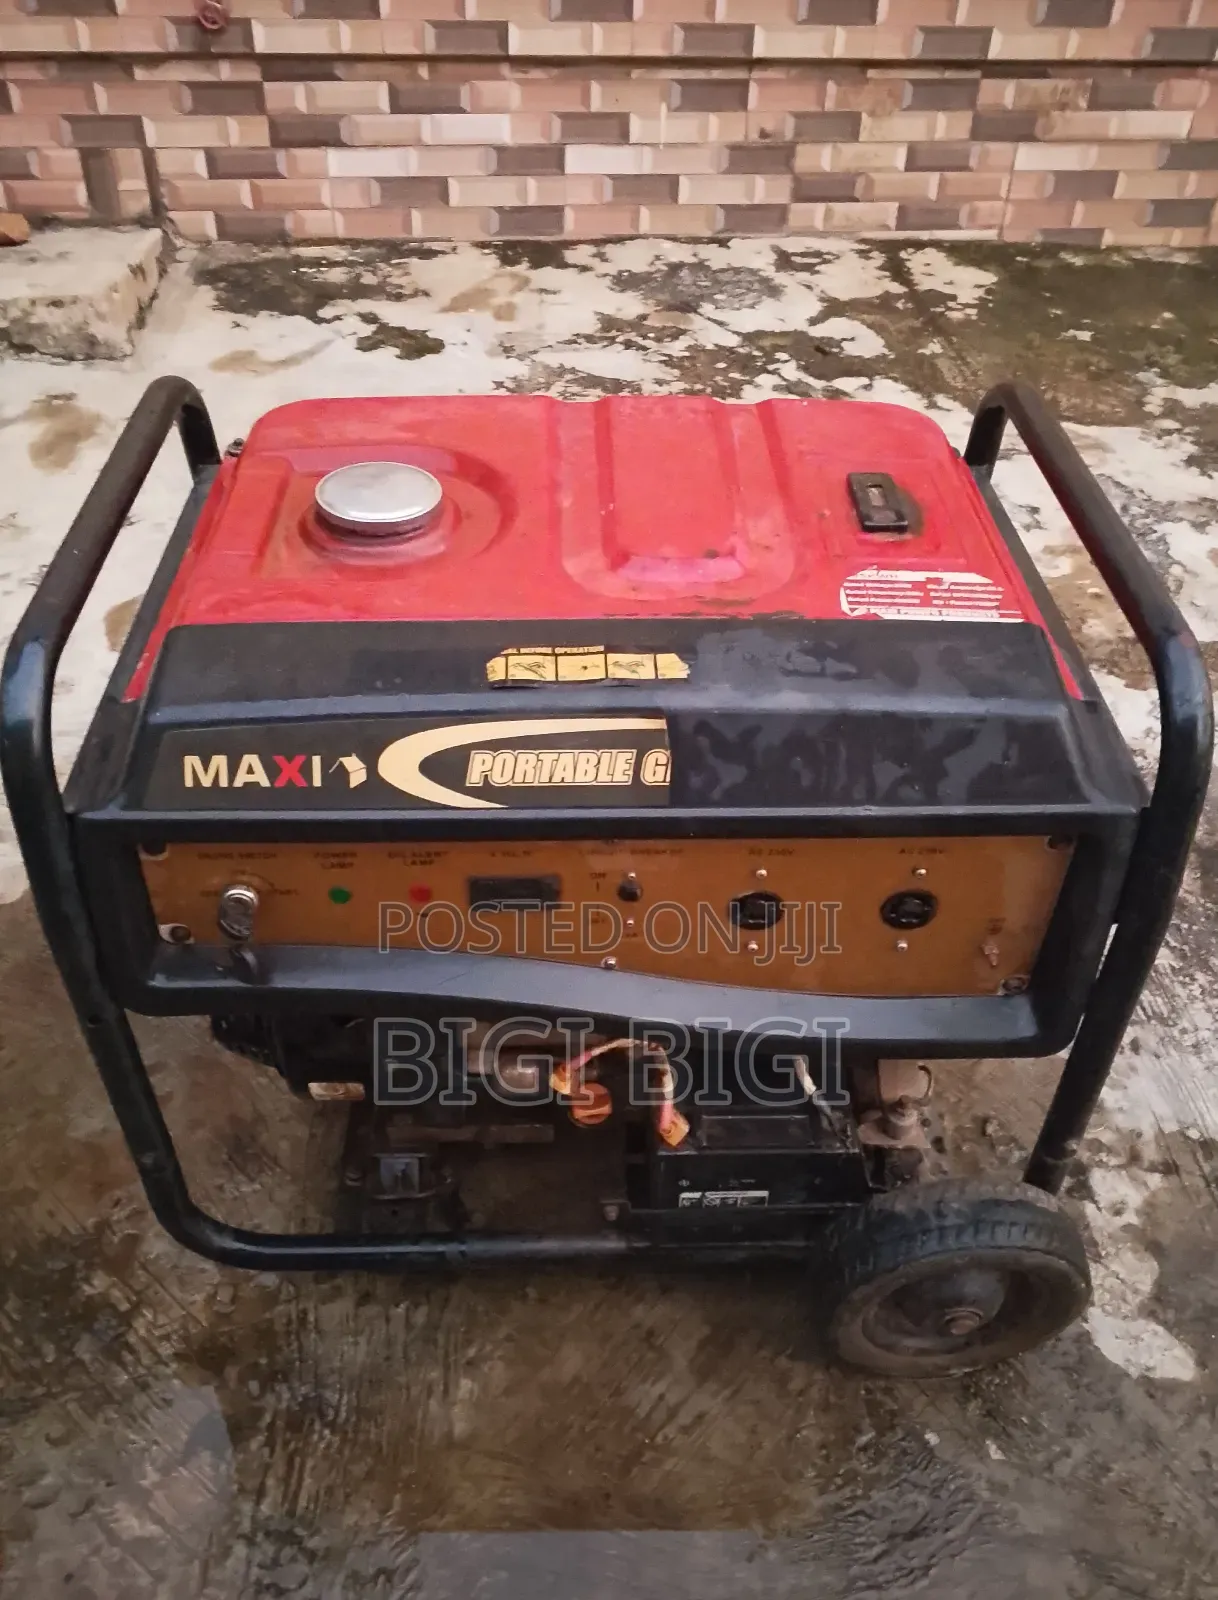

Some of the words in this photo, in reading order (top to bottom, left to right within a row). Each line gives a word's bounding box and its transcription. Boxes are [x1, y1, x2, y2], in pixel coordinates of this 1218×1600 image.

[182, 754, 323, 789] MAXI
[465, 748, 638, 788] PORTABLE
[640, 748, 671, 786] G
